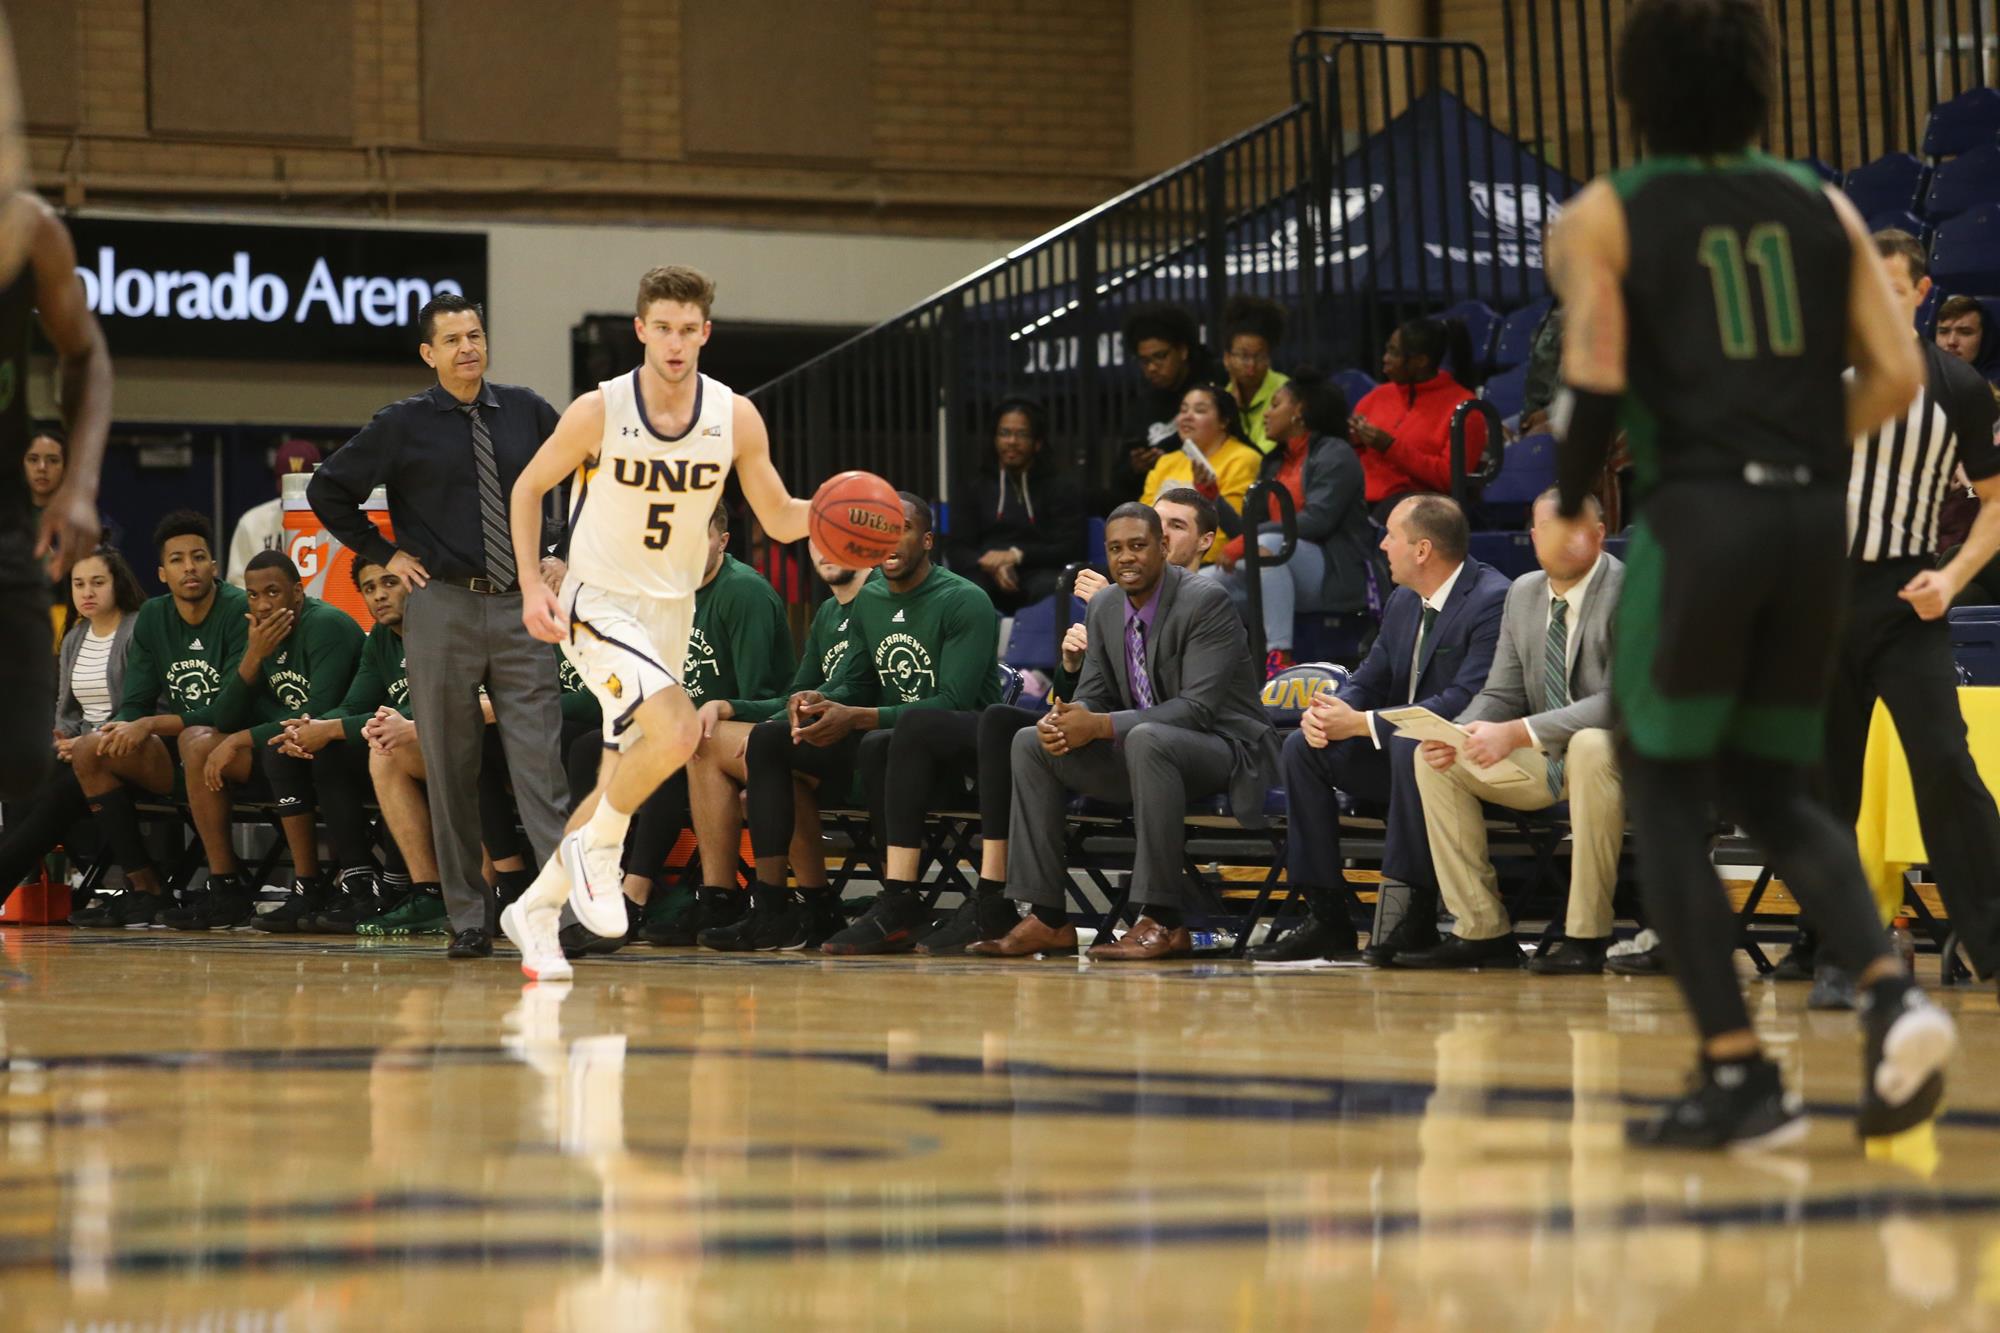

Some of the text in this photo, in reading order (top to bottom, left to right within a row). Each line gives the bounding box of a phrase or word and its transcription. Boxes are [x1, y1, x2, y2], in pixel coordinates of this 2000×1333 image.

[73, 245, 289, 322] olorado
[1698, 221, 1806, 360] 11
[613, 457, 721, 493] UNC
[643, 502, 675, 551] 5
[290, 535, 318, 577] G
[875, 633, 931, 666] SACRAMENTO
